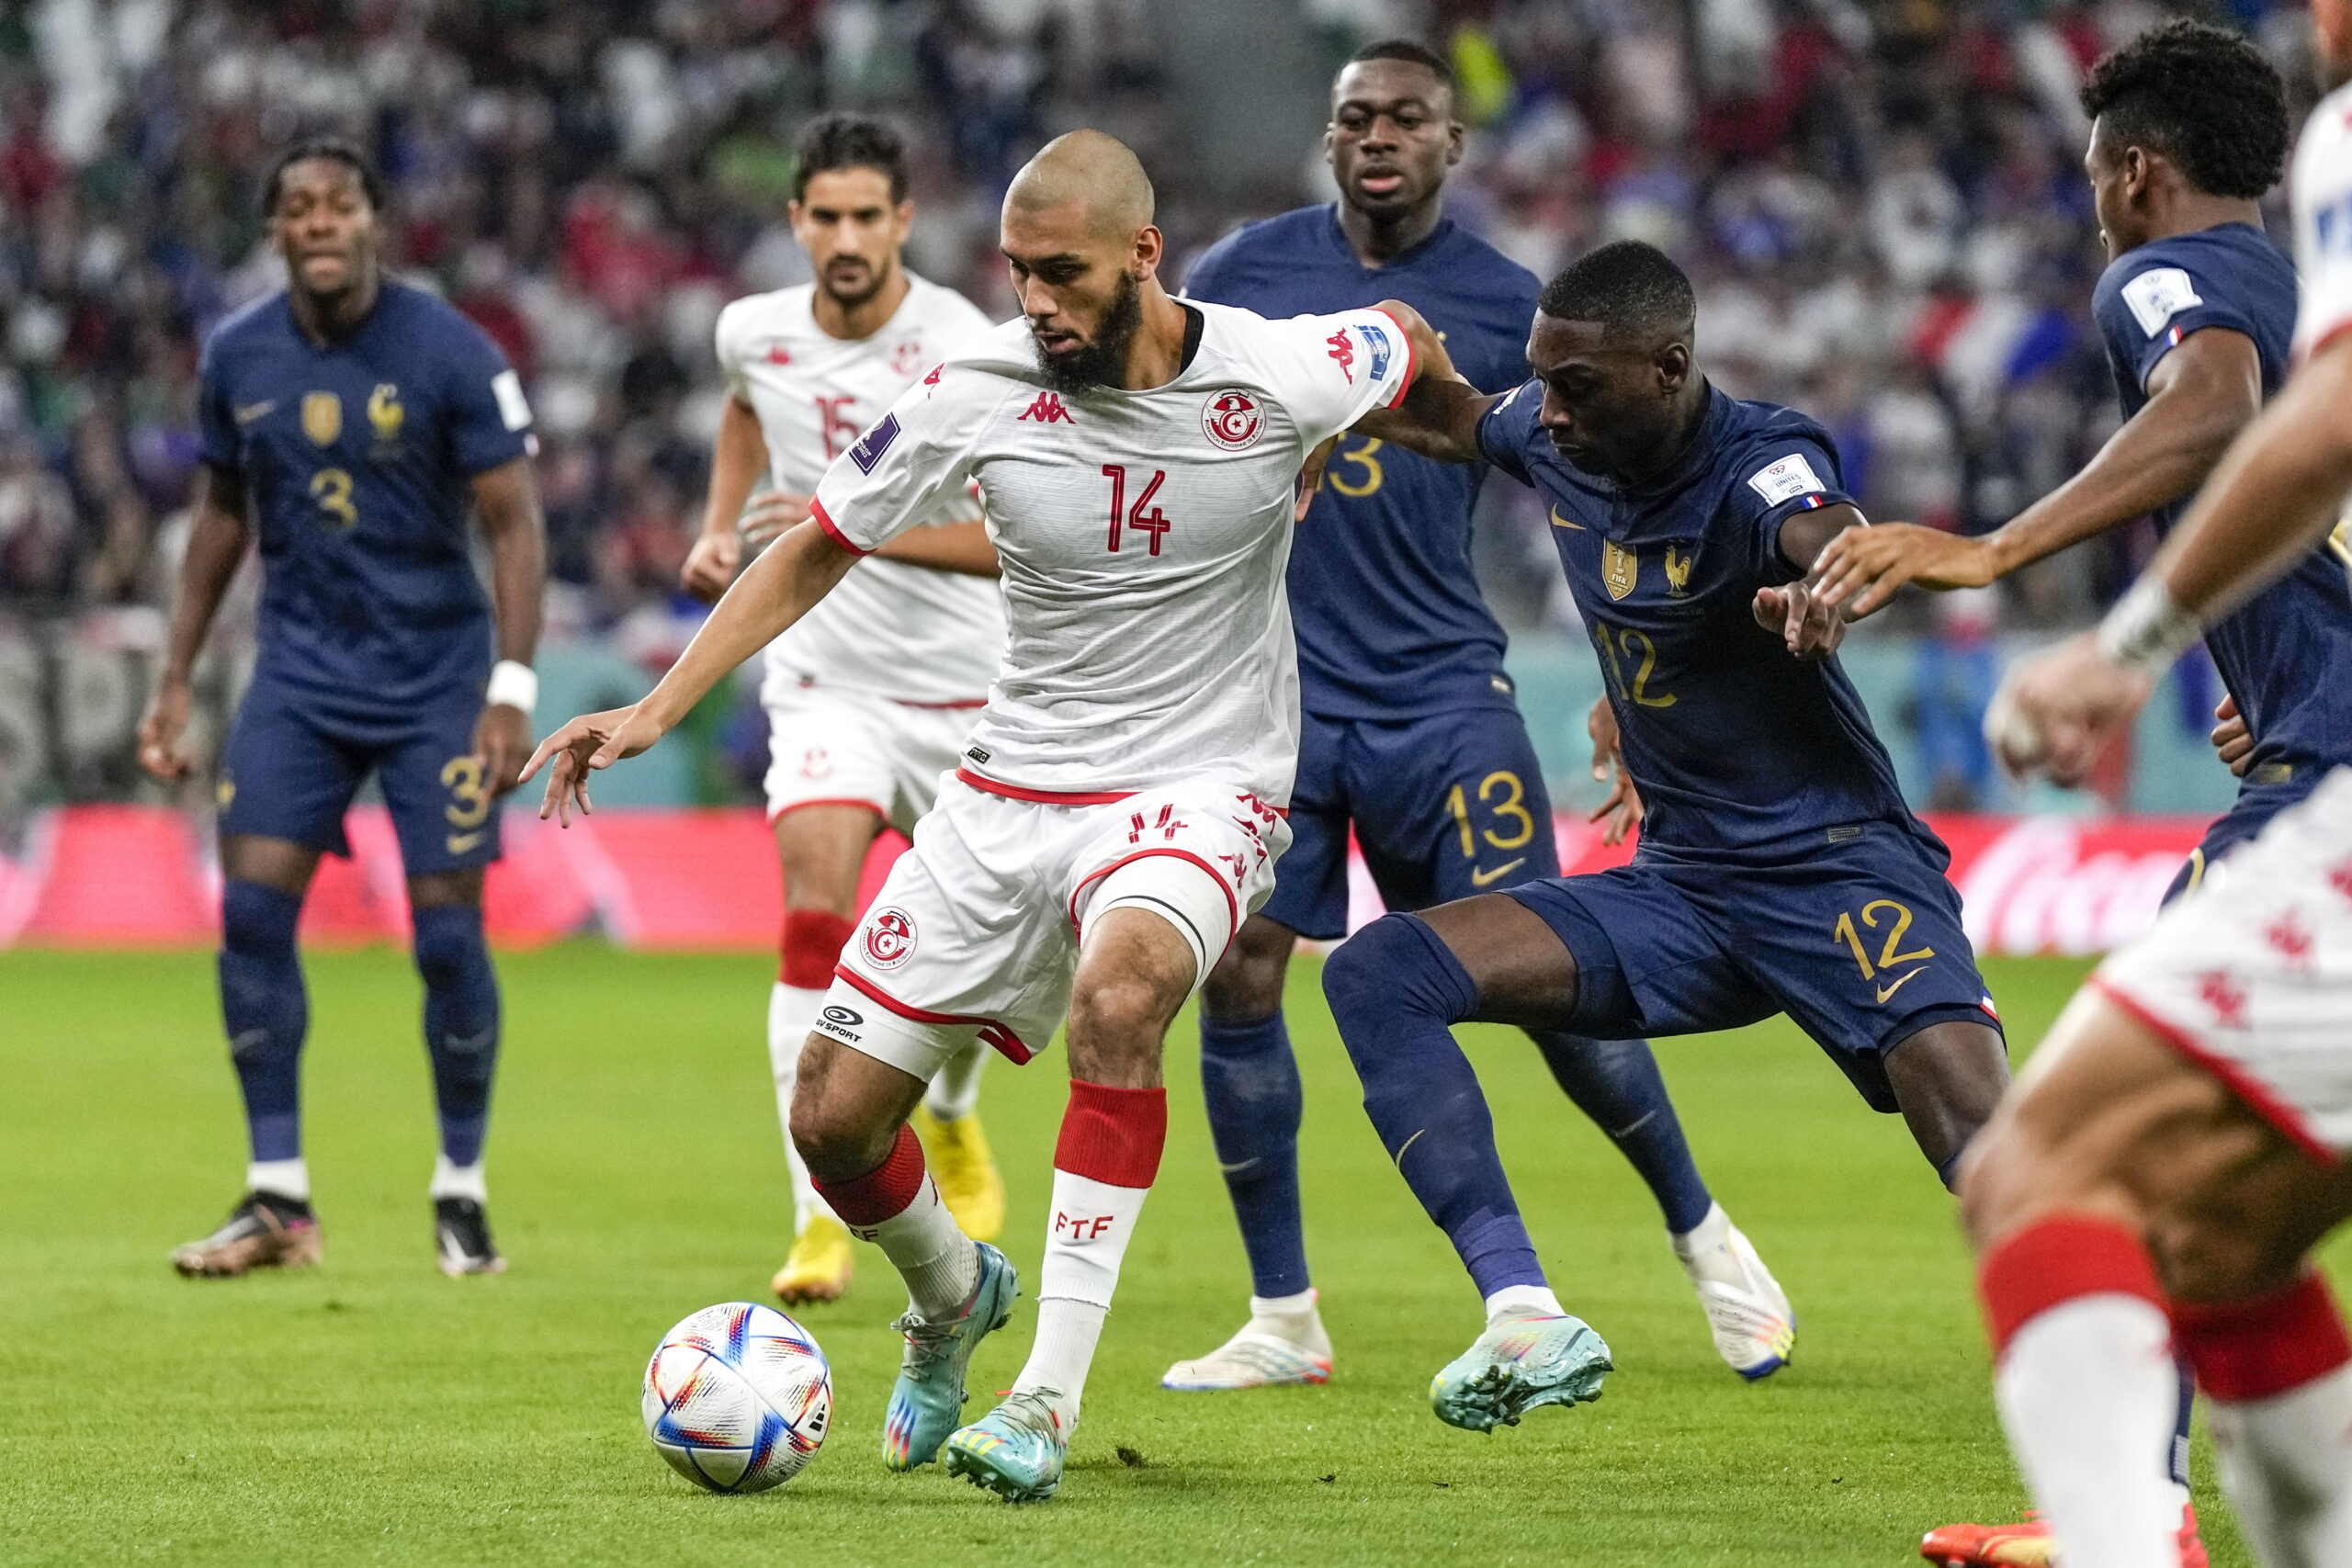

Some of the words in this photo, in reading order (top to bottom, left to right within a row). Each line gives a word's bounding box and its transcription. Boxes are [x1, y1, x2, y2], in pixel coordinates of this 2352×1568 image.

[814, 396, 859, 461] 15
[310, 468, 357, 532] 3
[1102, 464, 1170, 557] 14
[1611, 573, 1628, 585] FIFA
[1597, 623, 1678, 707] 12
[440, 756, 490, 828] 3
[1445, 771, 1533, 857] 13
[1834, 899, 1936, 981] 12
[825, 1022, 863, 1043] SPORT
[1056, 1211, 1114, 1239] FTF
